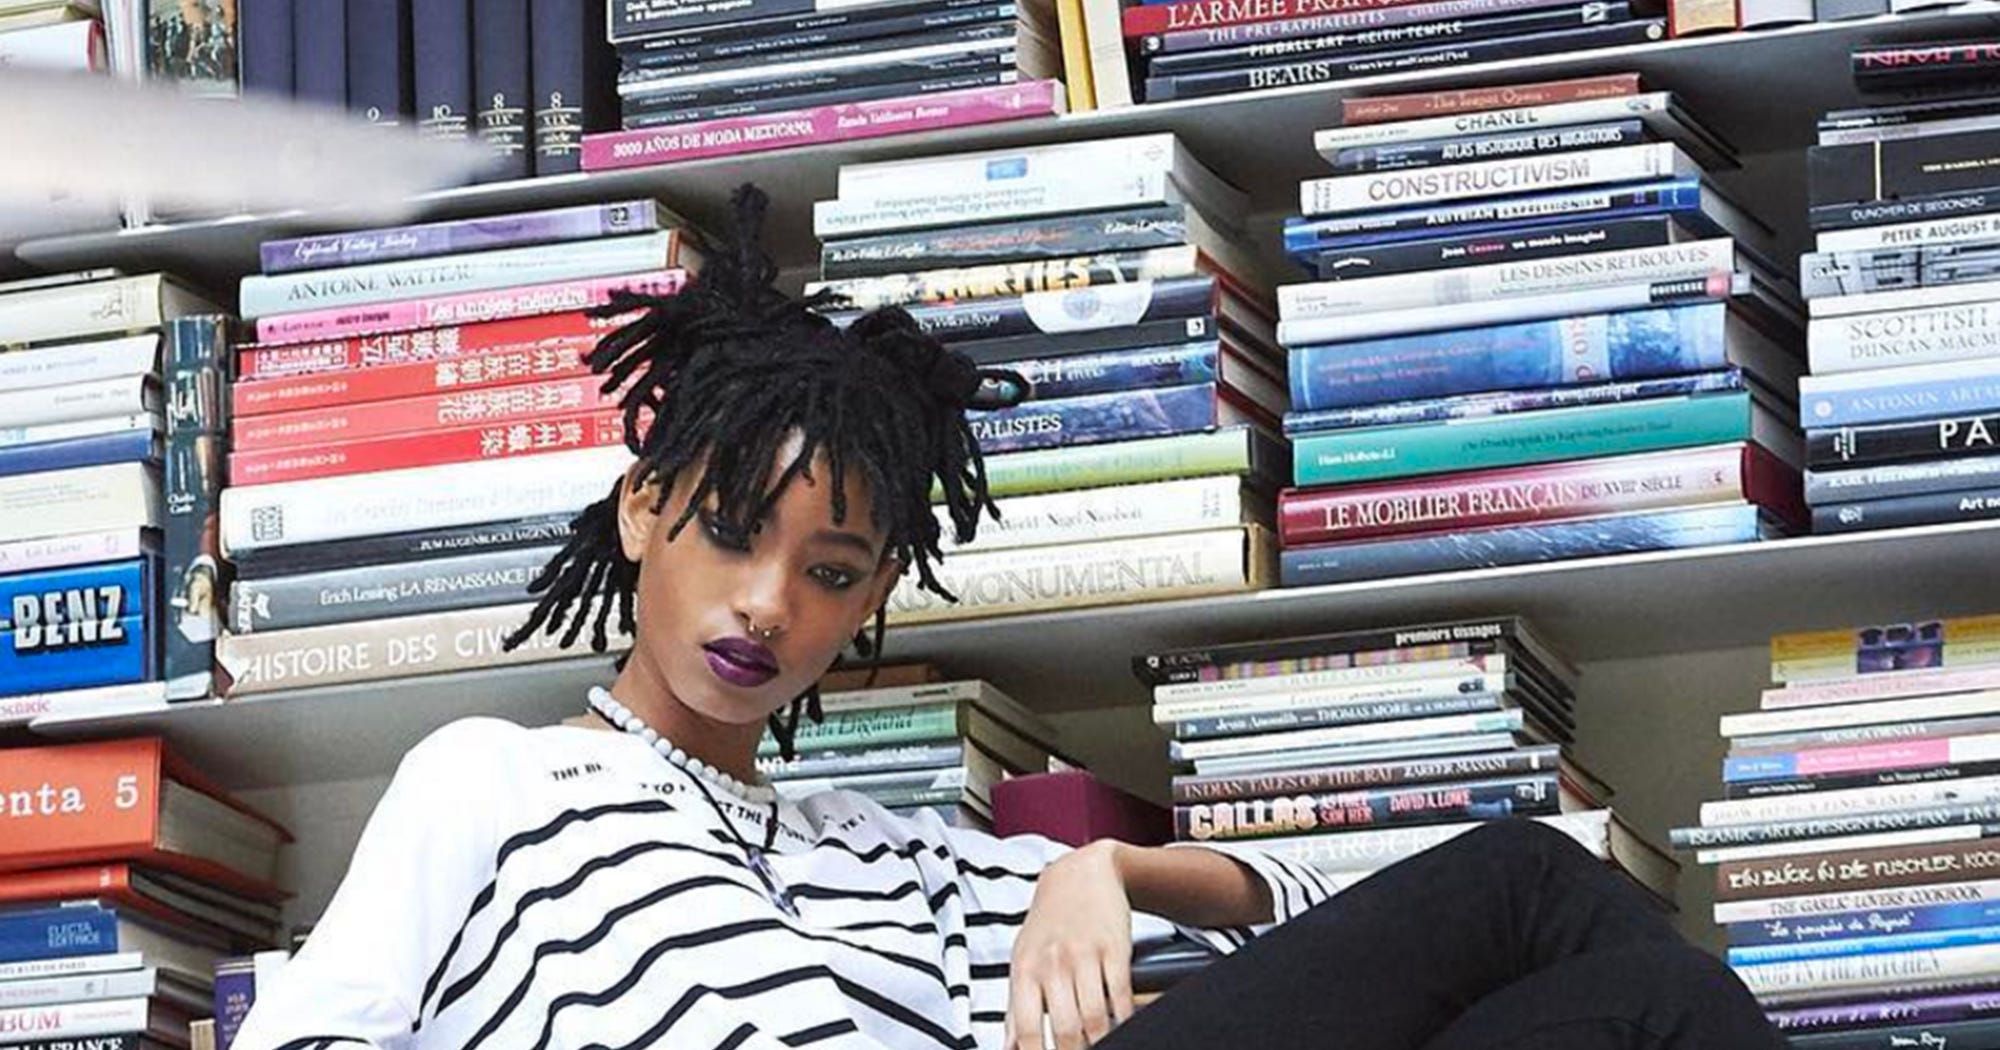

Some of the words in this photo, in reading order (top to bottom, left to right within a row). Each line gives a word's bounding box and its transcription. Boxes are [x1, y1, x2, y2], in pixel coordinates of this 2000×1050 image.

[1207, 27, 1237, 43] THE
[1249, 63, 1331, 88] BEARS
[1455, 110, 1539, 132] CHANEL
[682, 132, 701, 149] DE
[702, 129, 743, 147] MODA
[1368, 157, 1591, 202] CONSTRUCTIVISM
[1881, 228, 1923, 244] PETER
[1928, 220, 1988, 239] AUGUST
[1500, 266, 1531, 283] LES
[288, 279, 381, 302] ANTOINE
[1850, 306, 1989, 341] SCOTTISH
[1850, 337, 1932, 360] DUNCAN
[1324, 505, 1351, 530] LE
[1356, 491, 1463, 527] MOBILIER
[1467, 483, 1582, 514] FRANÇAIS
[319, 587, 351, 606] Erich
[400, 580, 421, 597] LA
[423, 567, 526, 594] RENAISSANCE
[945, 551, 1215, 606] MONUMENTAL
[247, 641, 372, 684] HISTOIRE
[388, 633, 438, 668] DES
[115, 775, 139, 809] 5
[1185, 780, 1244, 799] INDIAN
[1249, 777, 1298, 793] TALES
[1300, 774, 1320, 789] OF
[1328, 769, 1362, 786] THE
[1437, 789, 1473, 806] LOWE
[1189, 794, 1318, 839] CALLAS
[1690, 829, 1754, 846] ISLAMIC
[1761, 825, 1791, 839] ART
[1807, 817, 1871, 836] DESIGN
